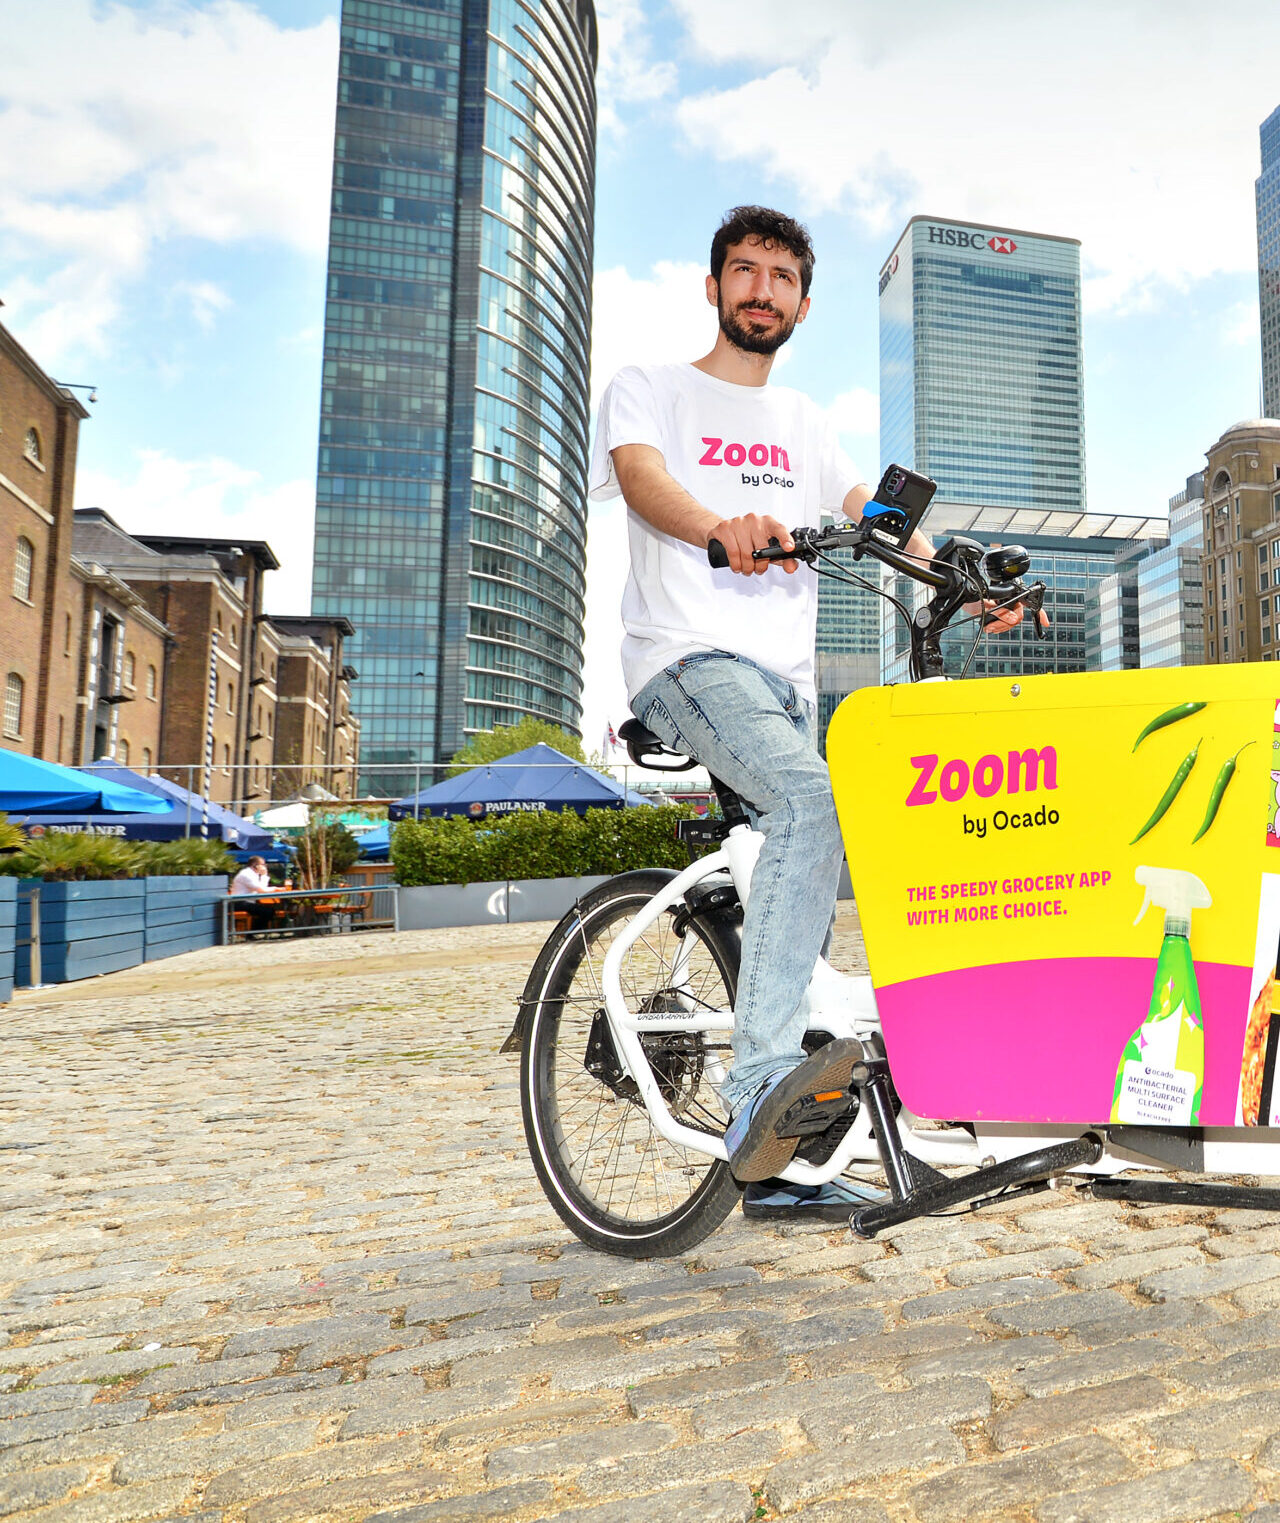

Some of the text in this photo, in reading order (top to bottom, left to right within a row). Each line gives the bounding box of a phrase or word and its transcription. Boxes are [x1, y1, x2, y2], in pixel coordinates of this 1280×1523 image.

[928, 226, 985, 250] HSBC
[742, 473, 760, 486] by
[905, 745, 1058, 807] Zoom
[485, 801, 547, 812] PAULANER
[963, 805, 1060, 838] by Ocado
[907, 870, 1112, 902] THE SPEEDY GROCERY APP
[907, 900, 1067, 926] WITH MORE CHOICE.
[1128, 1076, 1187, 1095] ANTIBACTERIAL
[1138, 1098, 1174, 1112] CLEANER
[1151, 1091, 1186, 1105] SURFACE
